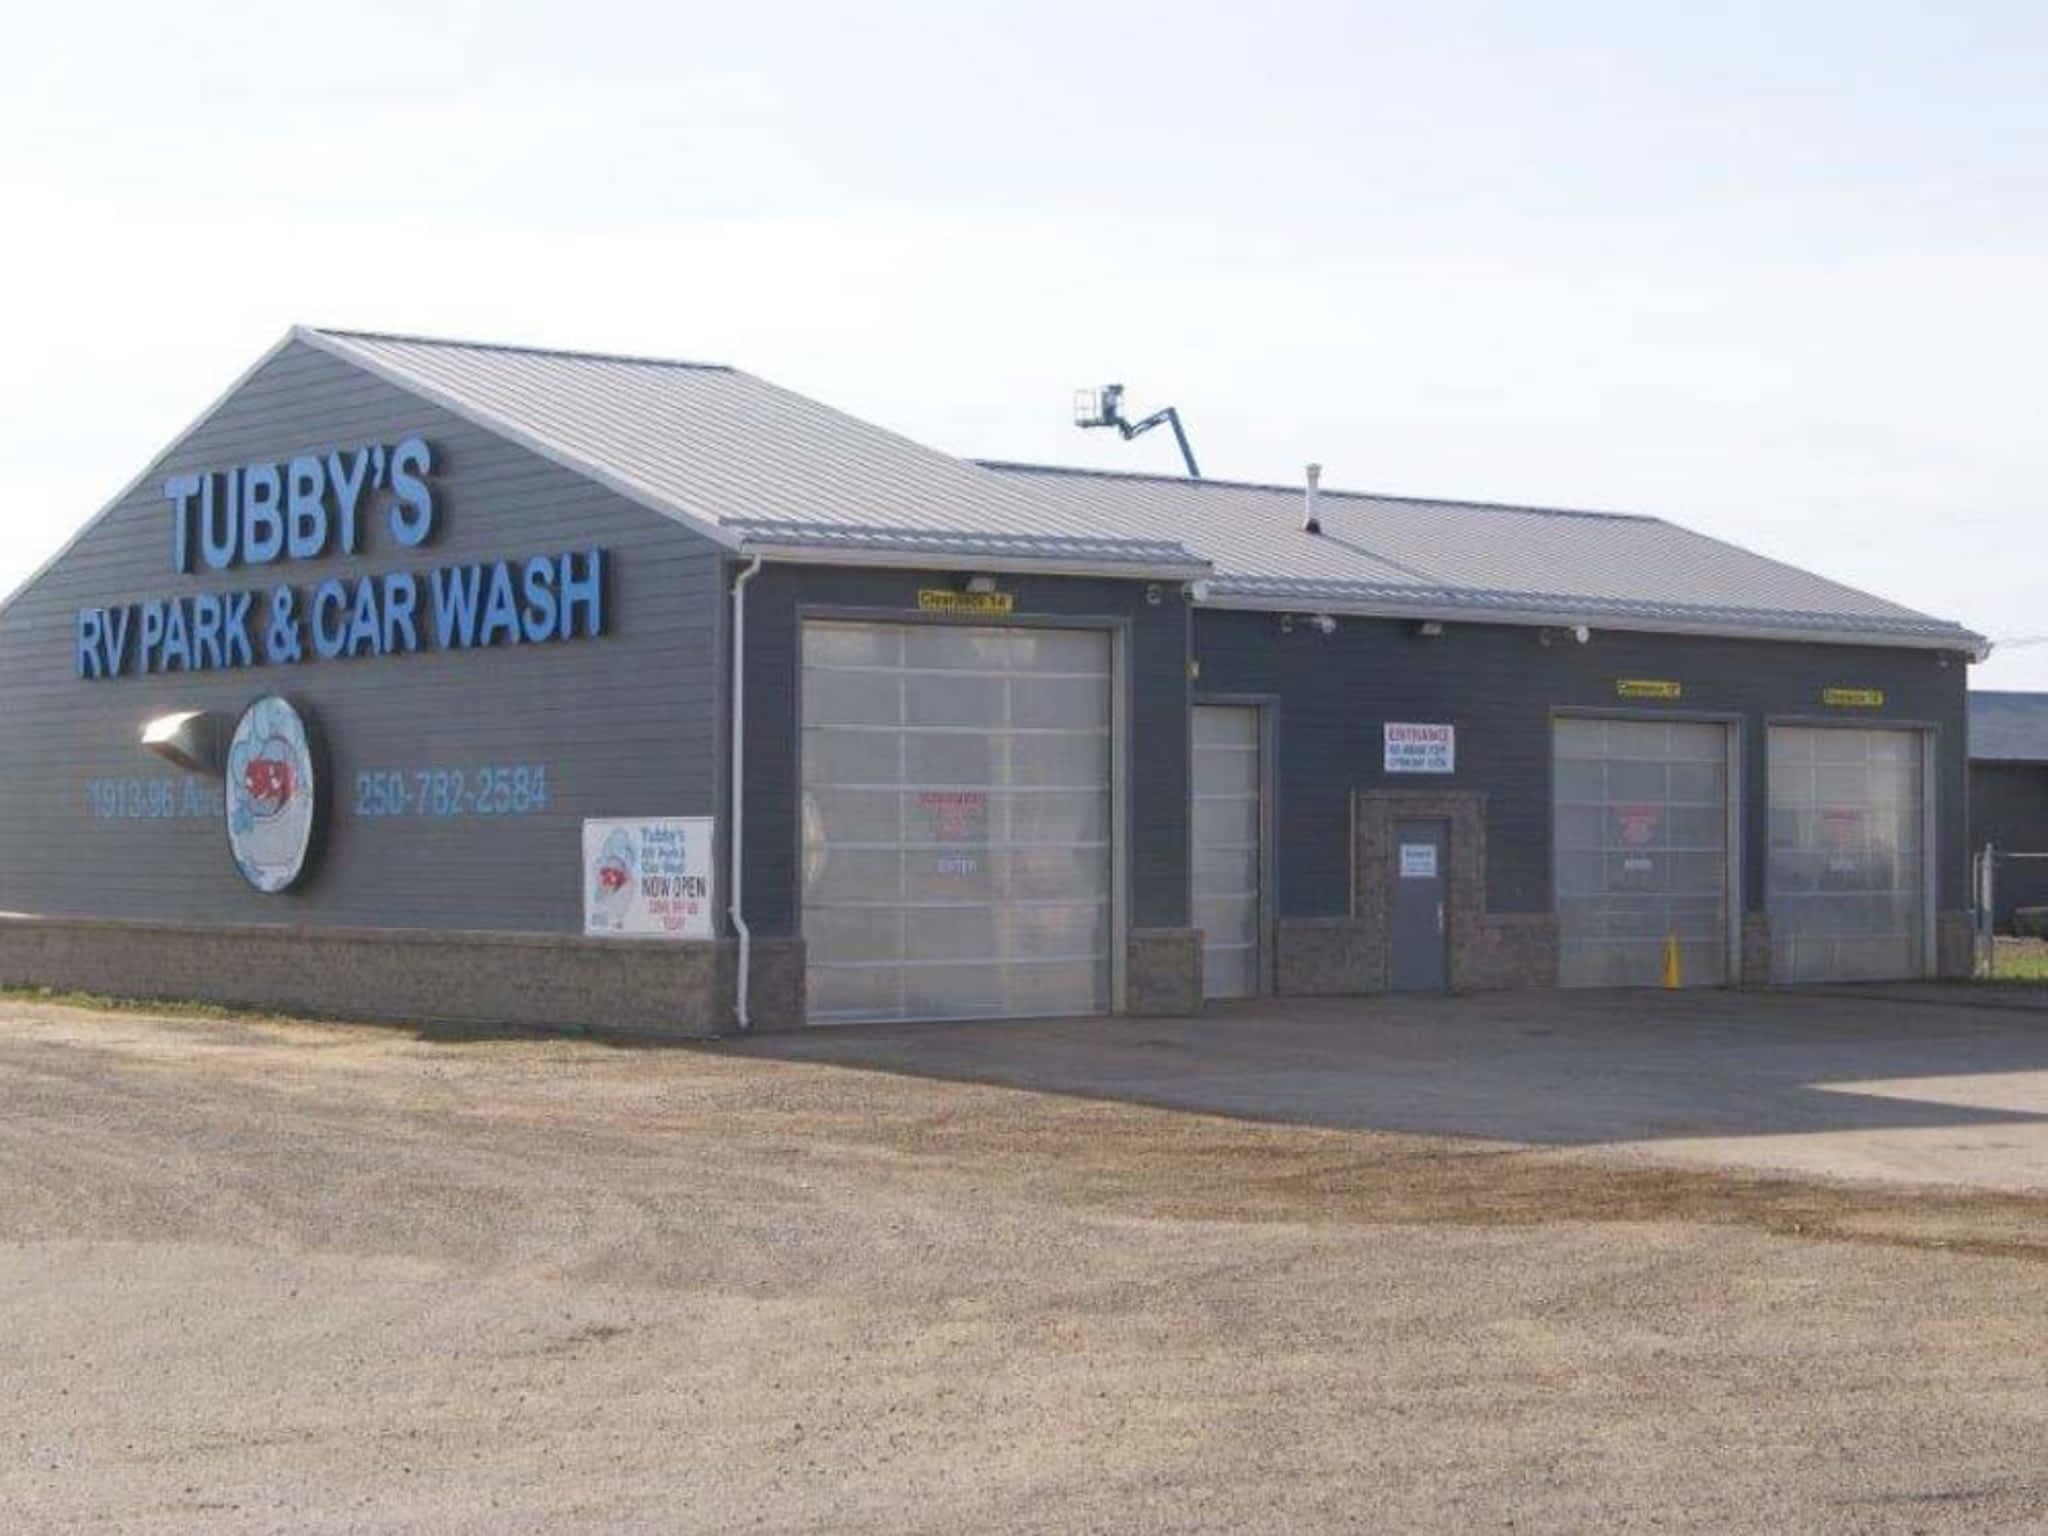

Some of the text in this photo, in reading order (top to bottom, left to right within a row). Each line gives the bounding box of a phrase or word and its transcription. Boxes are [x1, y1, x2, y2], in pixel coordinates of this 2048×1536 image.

[163, 434, 435, 575] TUBBY'S
[77, 545, 603, 679] RV PARK & CAR WASH
[354, 764, 552, 817] 250-782-2584
[641, 875, 706, 898] NOW OPEN
